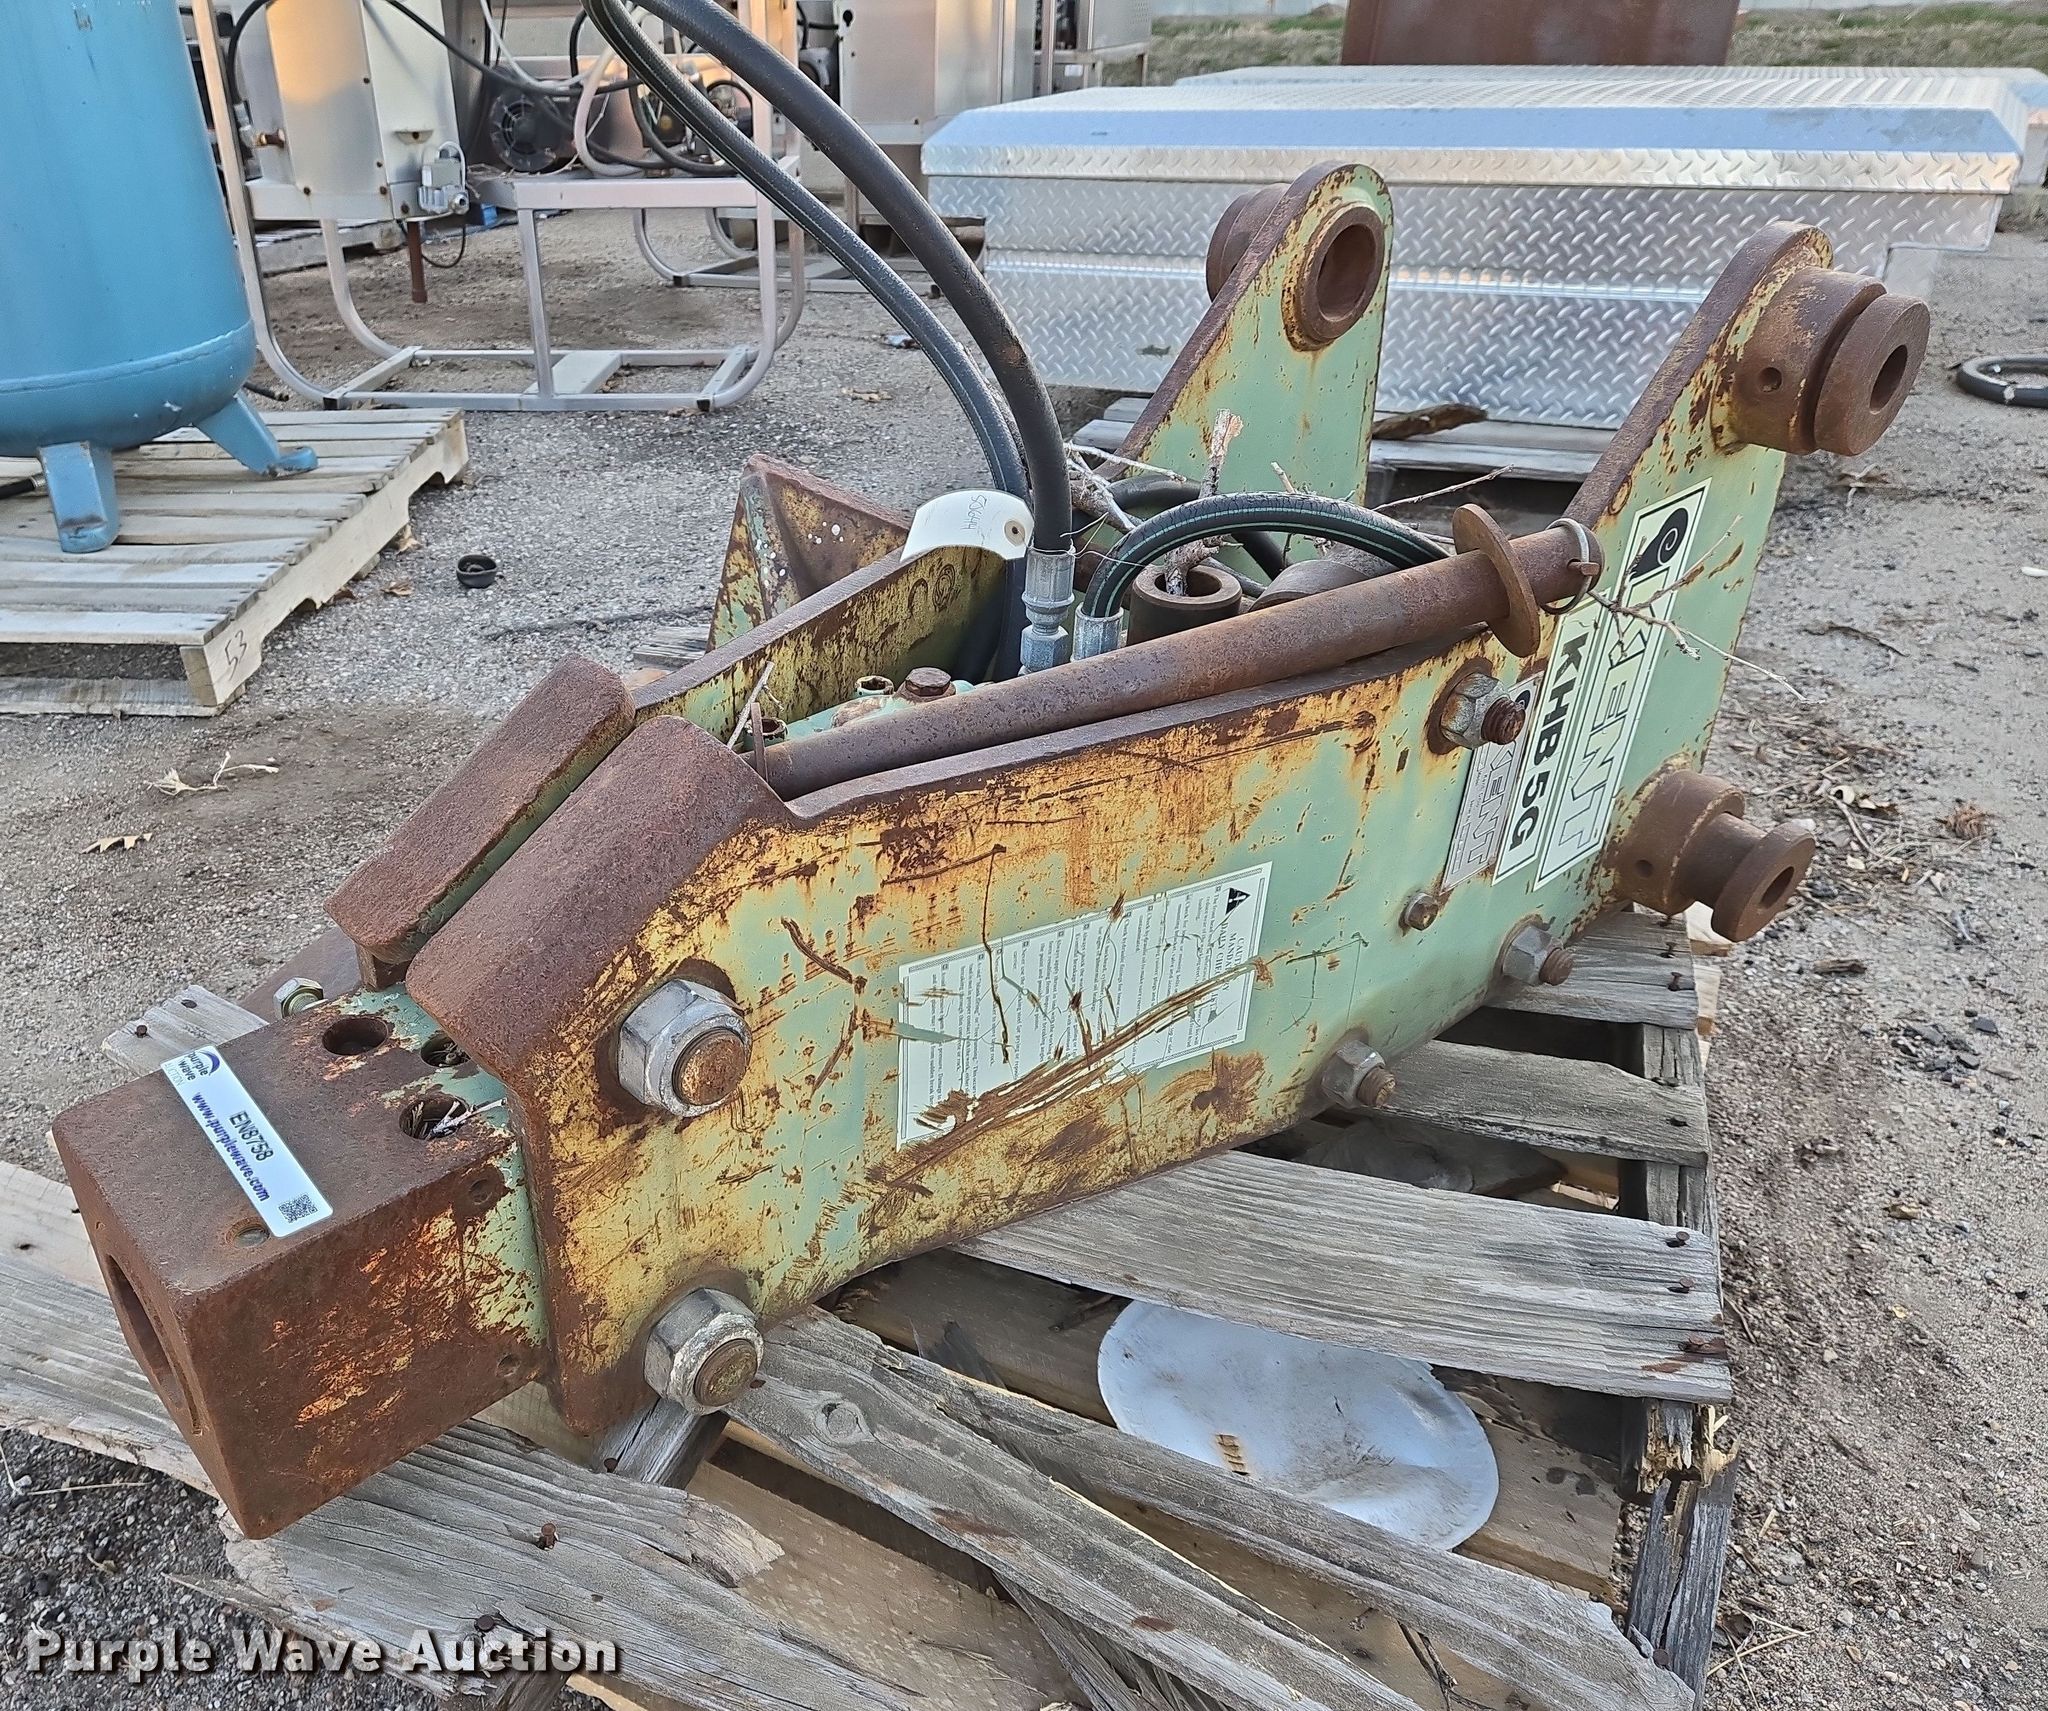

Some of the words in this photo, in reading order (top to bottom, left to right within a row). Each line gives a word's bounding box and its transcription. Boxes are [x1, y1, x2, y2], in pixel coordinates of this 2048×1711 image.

[225, 629, 247, 681] 53
[1558, 566, 1671, 849] KENT
[1216, 921, 1228, 951] DAILY
[178, 1060, 197, 1081] wave
[186, 1051, 209, 1077] purple
[191, 1091, 271, 1202] www.purplewave.com
[229, 1110, 275, 1162] EN8758
